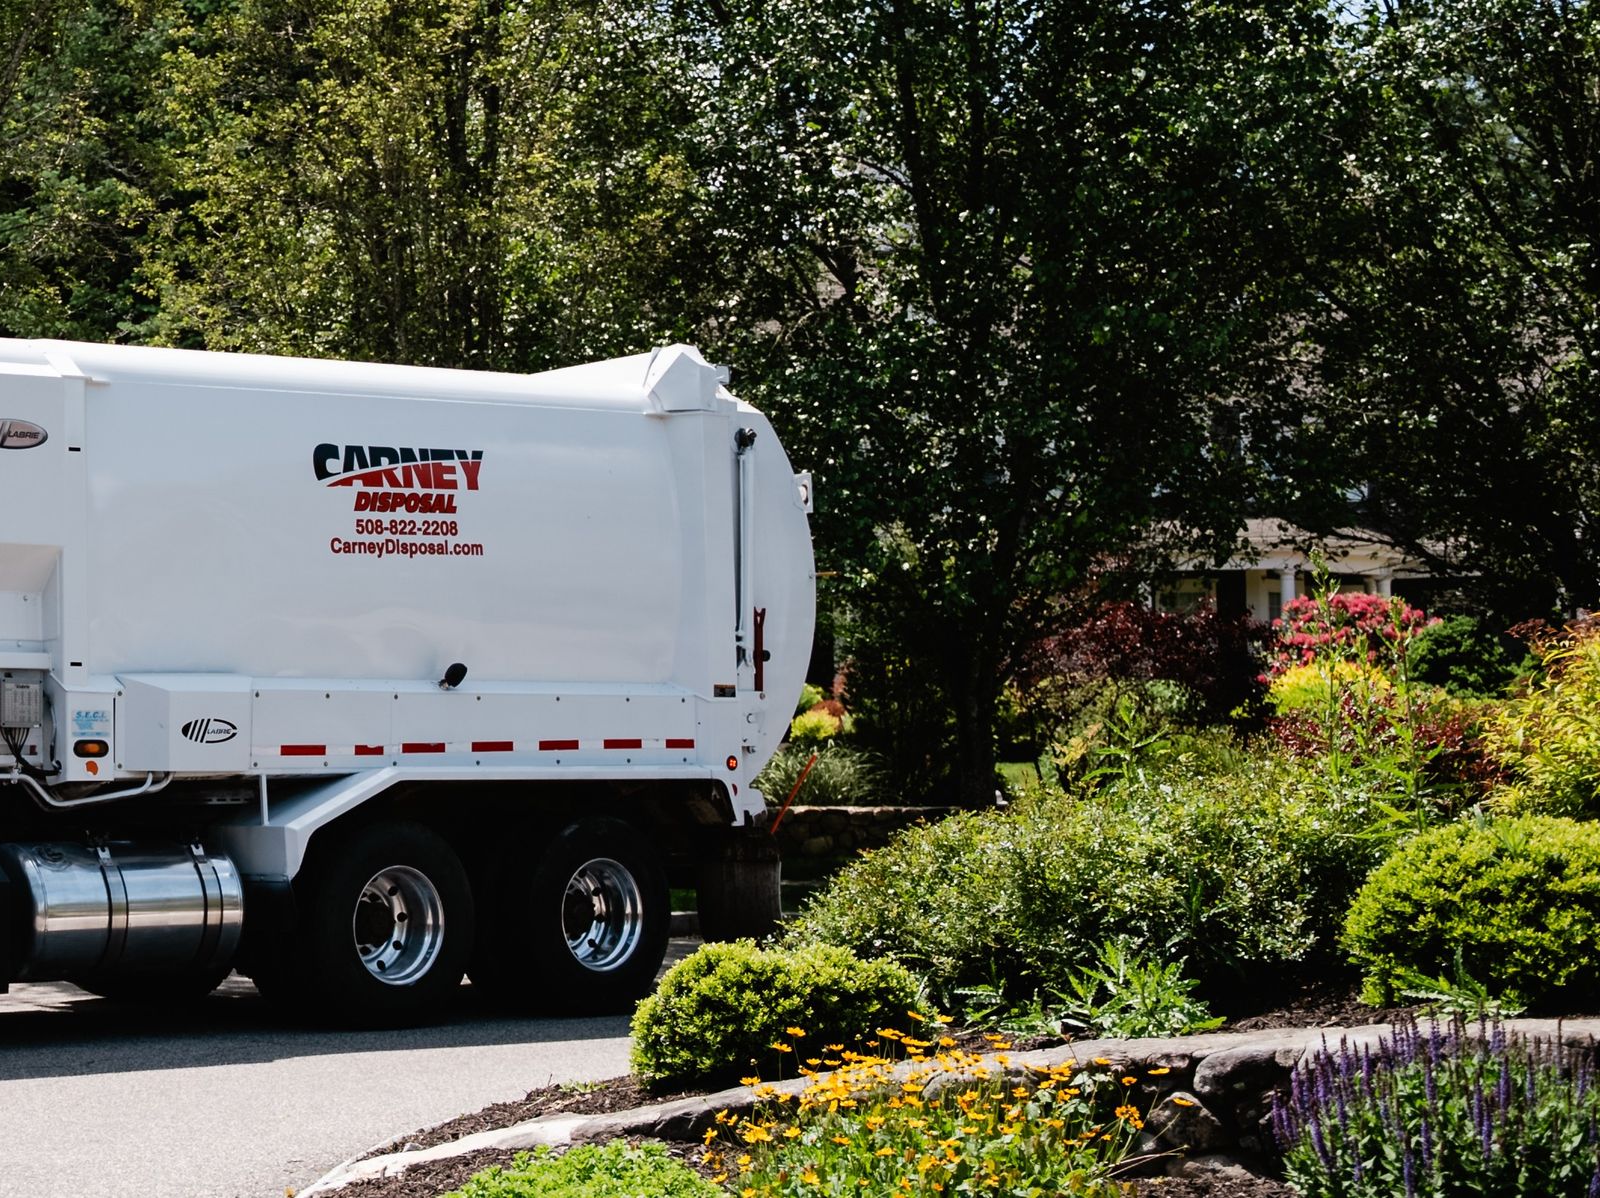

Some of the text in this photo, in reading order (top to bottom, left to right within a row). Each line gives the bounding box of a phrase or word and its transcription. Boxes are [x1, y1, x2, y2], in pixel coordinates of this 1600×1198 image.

[7, 430, 40, 440] LABRIE
[313, 443, 484, 491] CARNEY
[353, 491, 458, 514] DISPOSAL
[355, 518, 459, 536] 508-822-2208
[330, 537, 484, 558] CarneyDisposal.com
